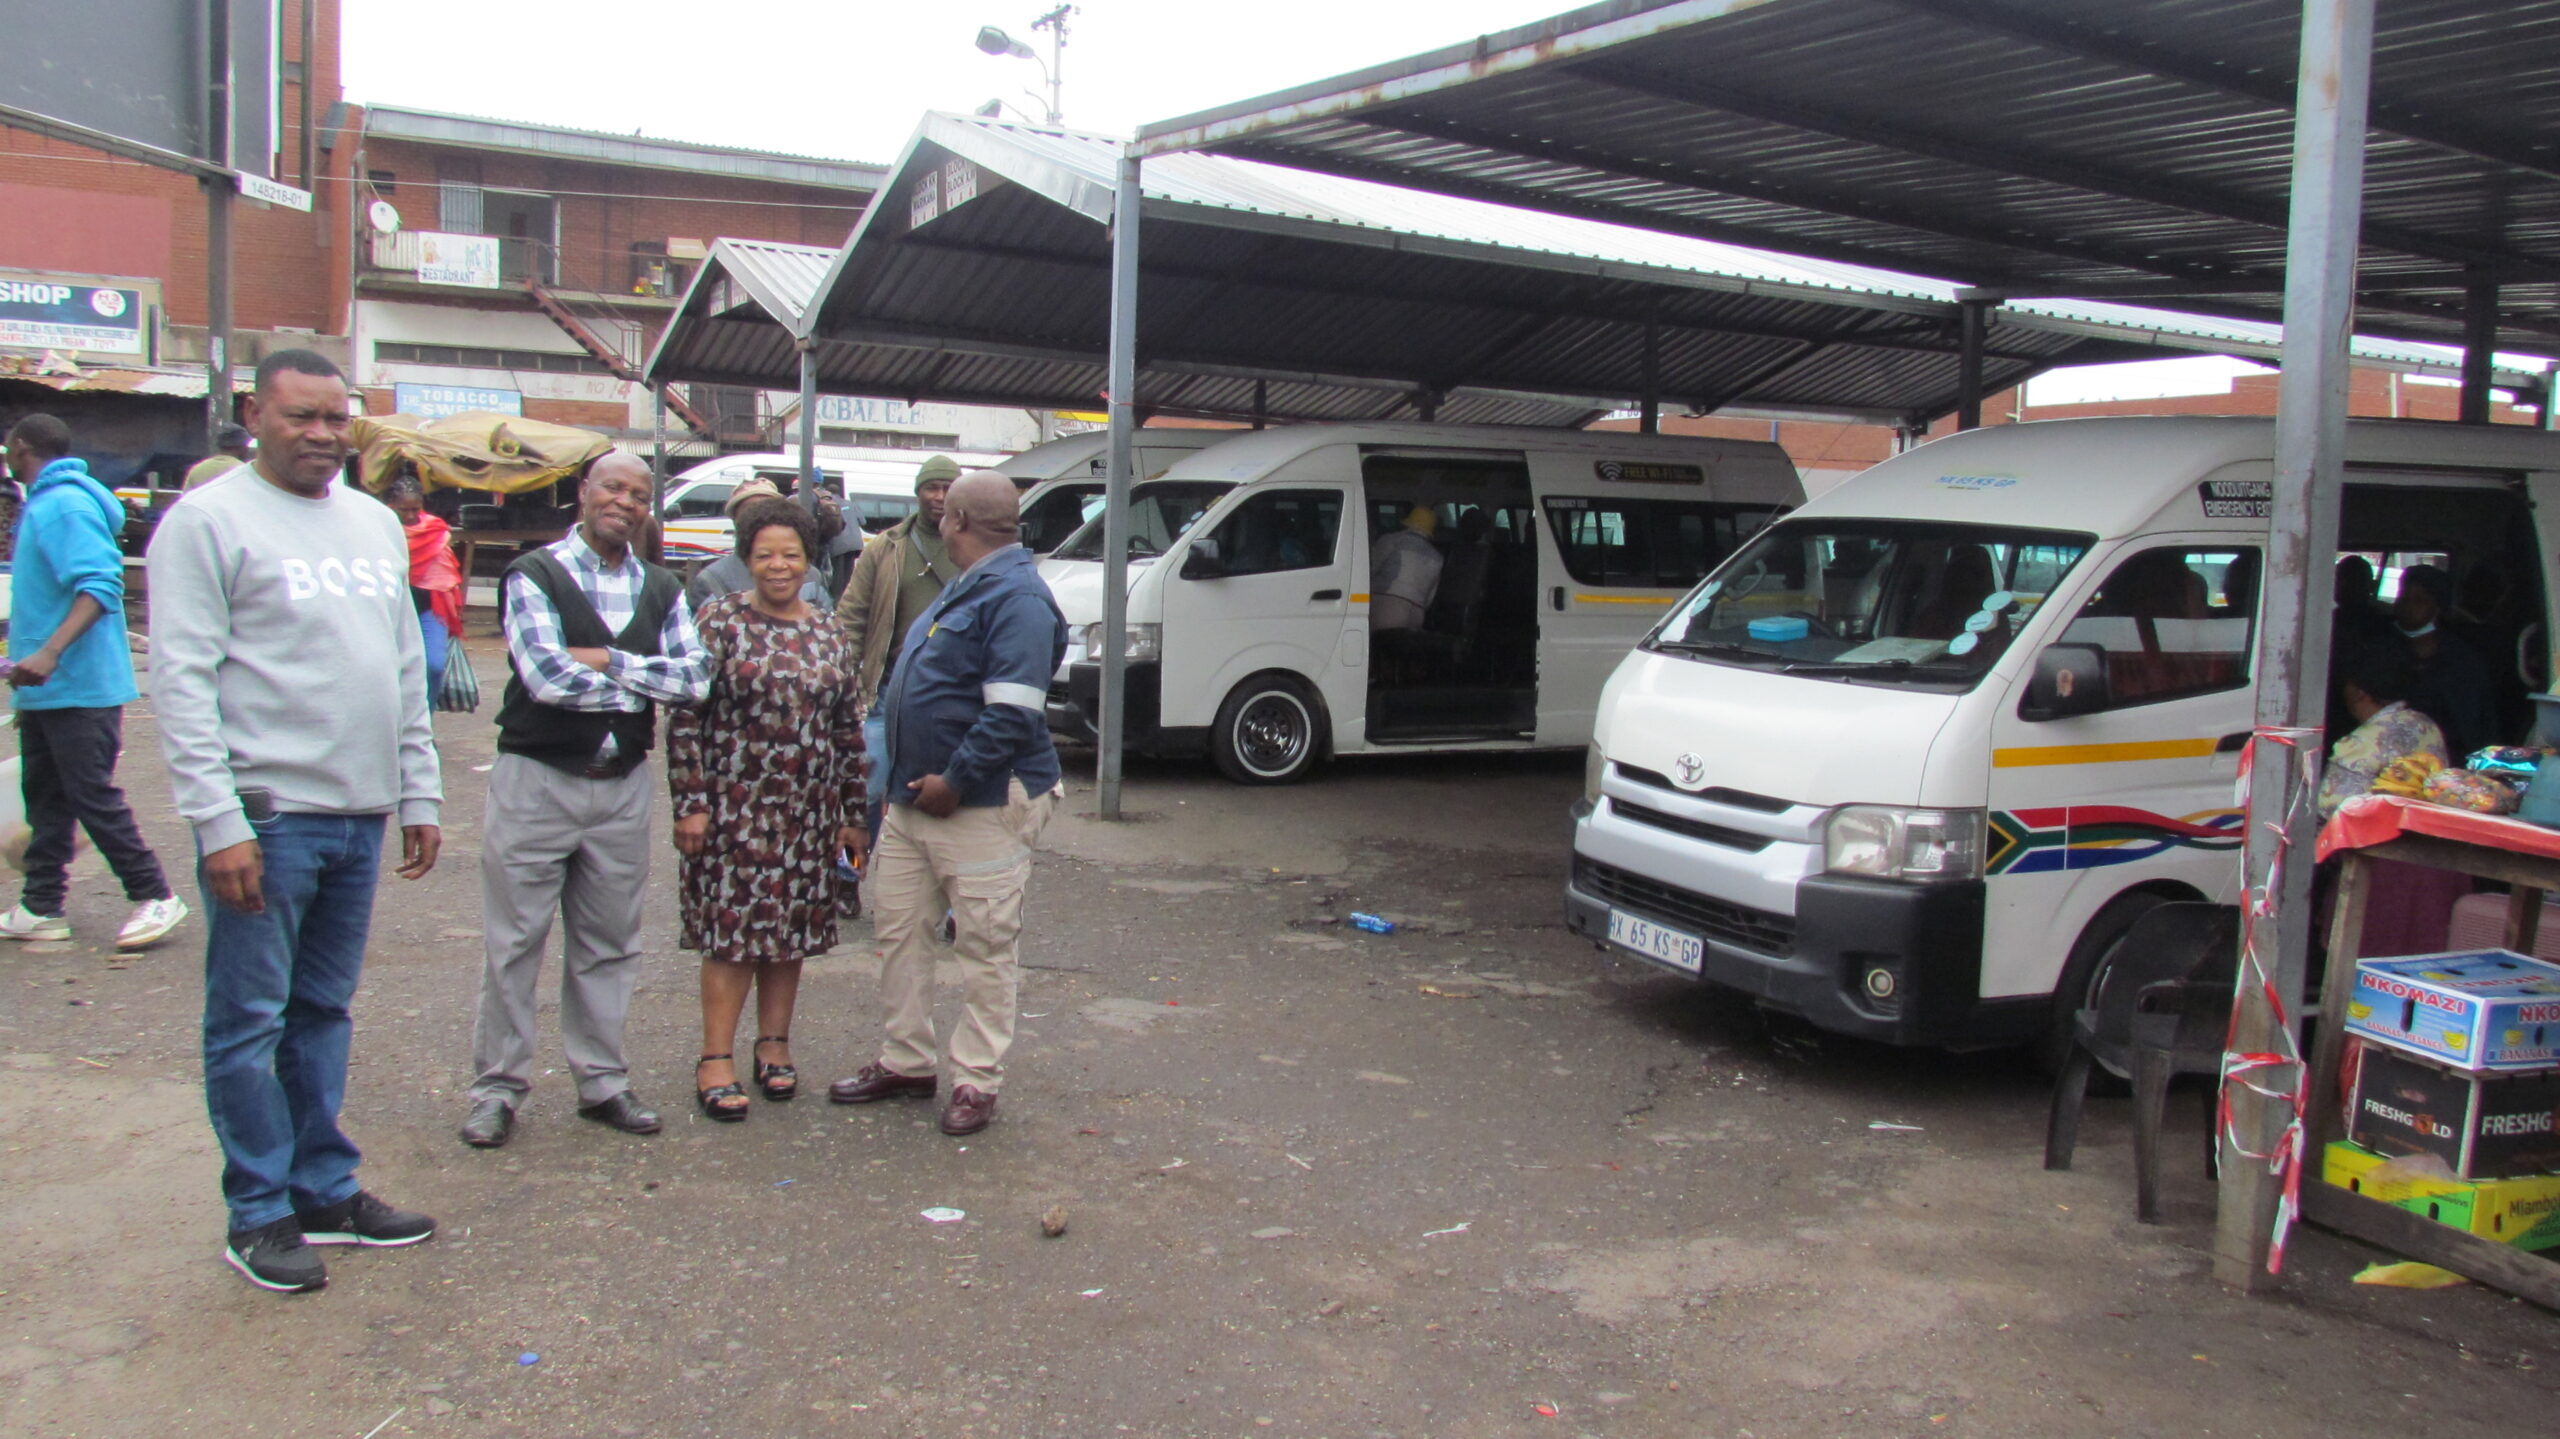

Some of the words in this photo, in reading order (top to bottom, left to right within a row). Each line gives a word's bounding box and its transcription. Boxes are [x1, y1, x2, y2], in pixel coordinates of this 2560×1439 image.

[0, 281, 72, 306] SHOP
[421, 389, 499, 405] TOBACCO
[2205, 500, 2256, 517] EMERGENCY
[281, 556, 401, 601] BOSS
[1610, 913, 1623, 939] HX
[1630, 920, 1647, 947] 65
[1654, 928, 1671, 957] KS
[1681, 938, 1700, 966] GP
[2361, 973, 2466, 1015] NKOMAZI
